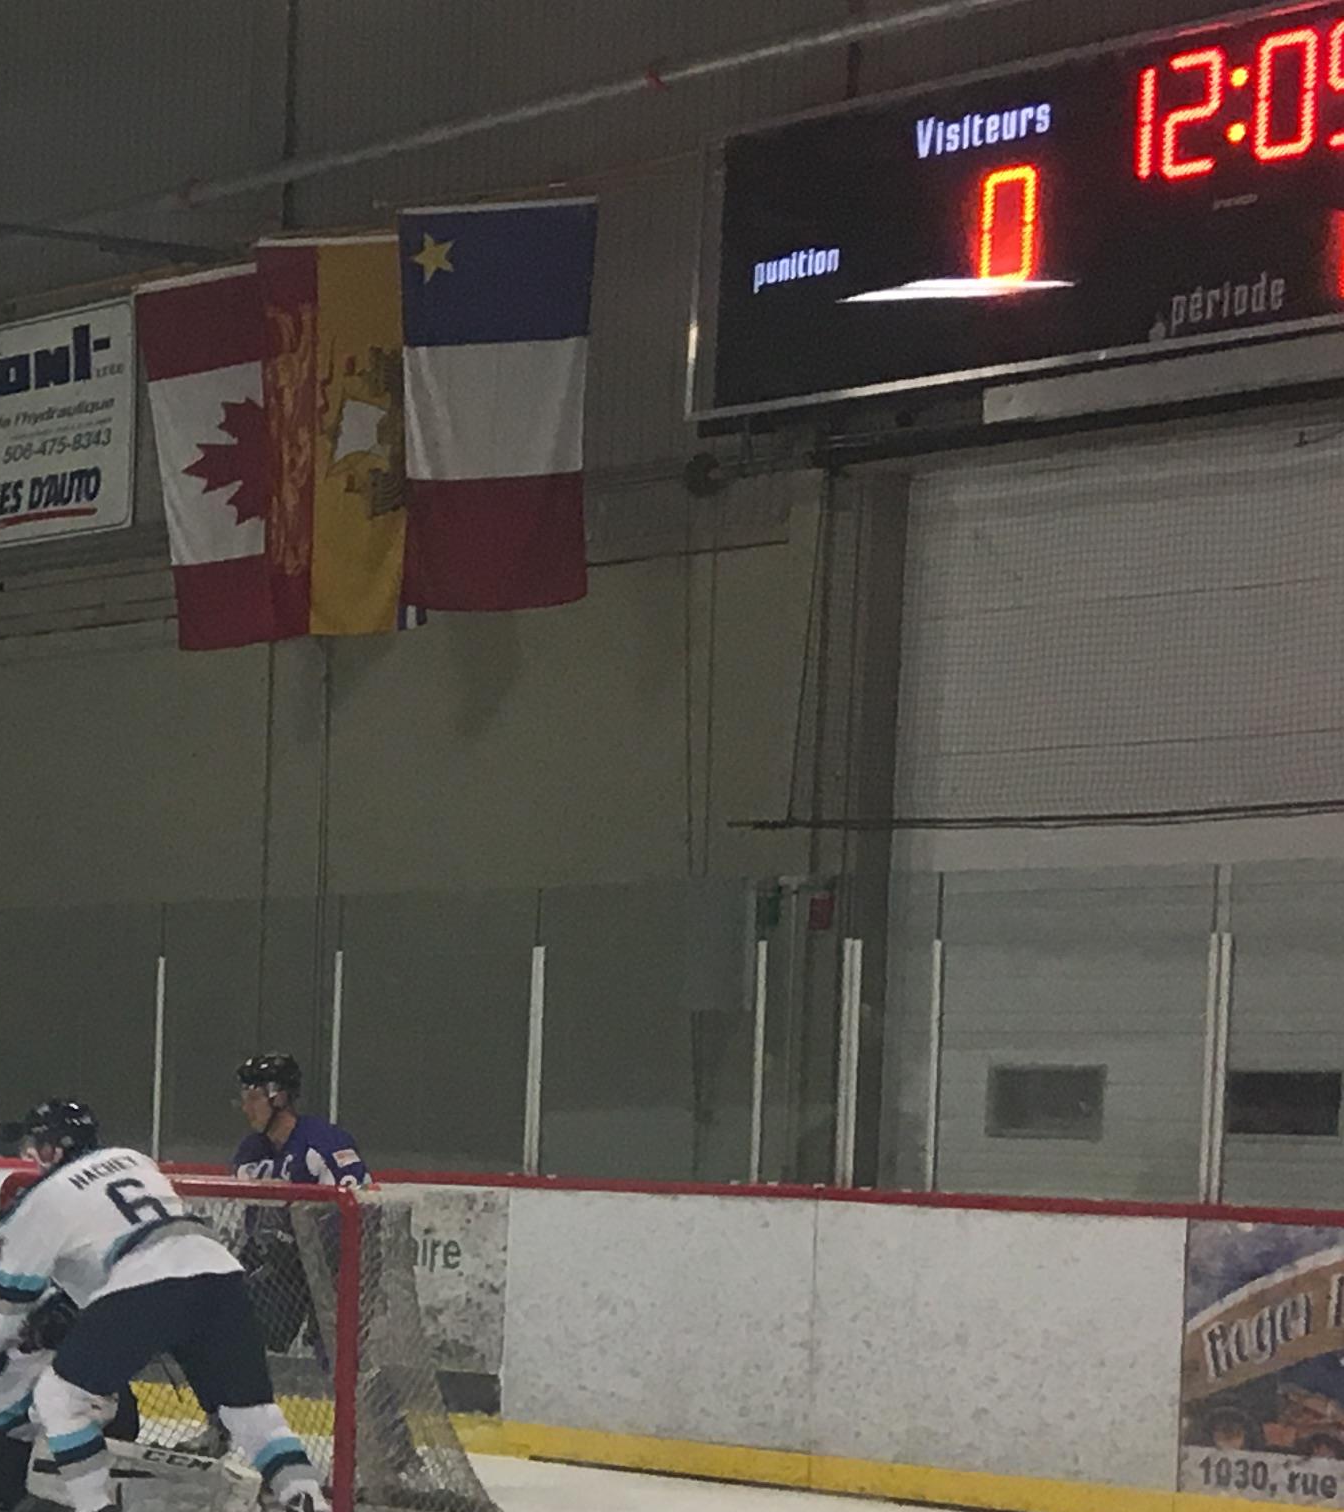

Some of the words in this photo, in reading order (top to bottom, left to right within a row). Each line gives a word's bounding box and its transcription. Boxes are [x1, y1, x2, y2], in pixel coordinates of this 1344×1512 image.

[1135, 20, 1344, 180] 12:0
[916, 103, 1052, 159] Visiteurs
[980, 165, 1037, 283] 0
[753, 246, 840, 293] punition
[1171, 271, 1286, 336] période
[28, 466, 102, 510] D'AUTO
[105, 1178, 170, 1226] 6
[1287, 1470, 1338, 1499] rue
